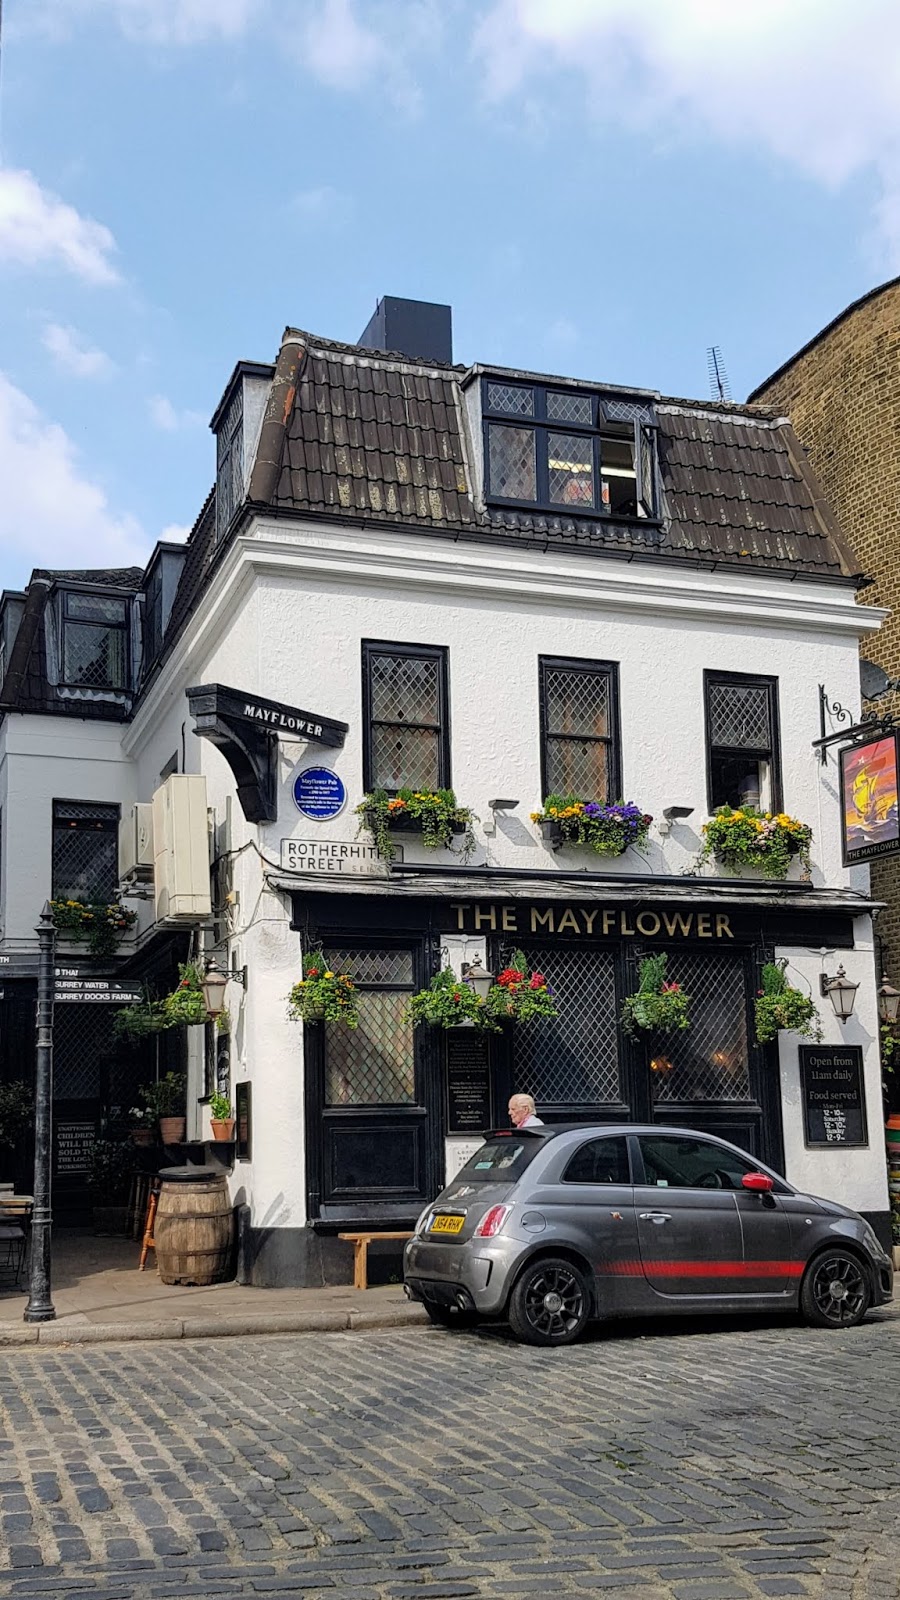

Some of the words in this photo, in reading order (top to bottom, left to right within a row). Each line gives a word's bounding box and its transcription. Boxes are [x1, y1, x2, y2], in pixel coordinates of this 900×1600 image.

[243, 704, 323, 737] MAYFLOWER
[848, 850, 861, 859] THE
[861, 840, 900, 856] MAYFLOWER
[289, 856, 345, 871] STREET
[450, 903, 518, 931] THE
[530, 907, 735, 938] MAYFLOWER
[54, 981, 82, 989] SURREY
[54, 992, 82, 1000] SURREY
[809, 1056, 832, 1068] Open
[833, 1056, 853, 1066] from
[811, 1070, 832, 1080] 11am
[832, 1070, 854, 1082] daily
[809, 1090, 829, 1100] Food
[830, 1089, 857, 1100] served
[57, 1132, 96, 1140] CHILDREN
[58, 1140, 81, 1148] WILL
